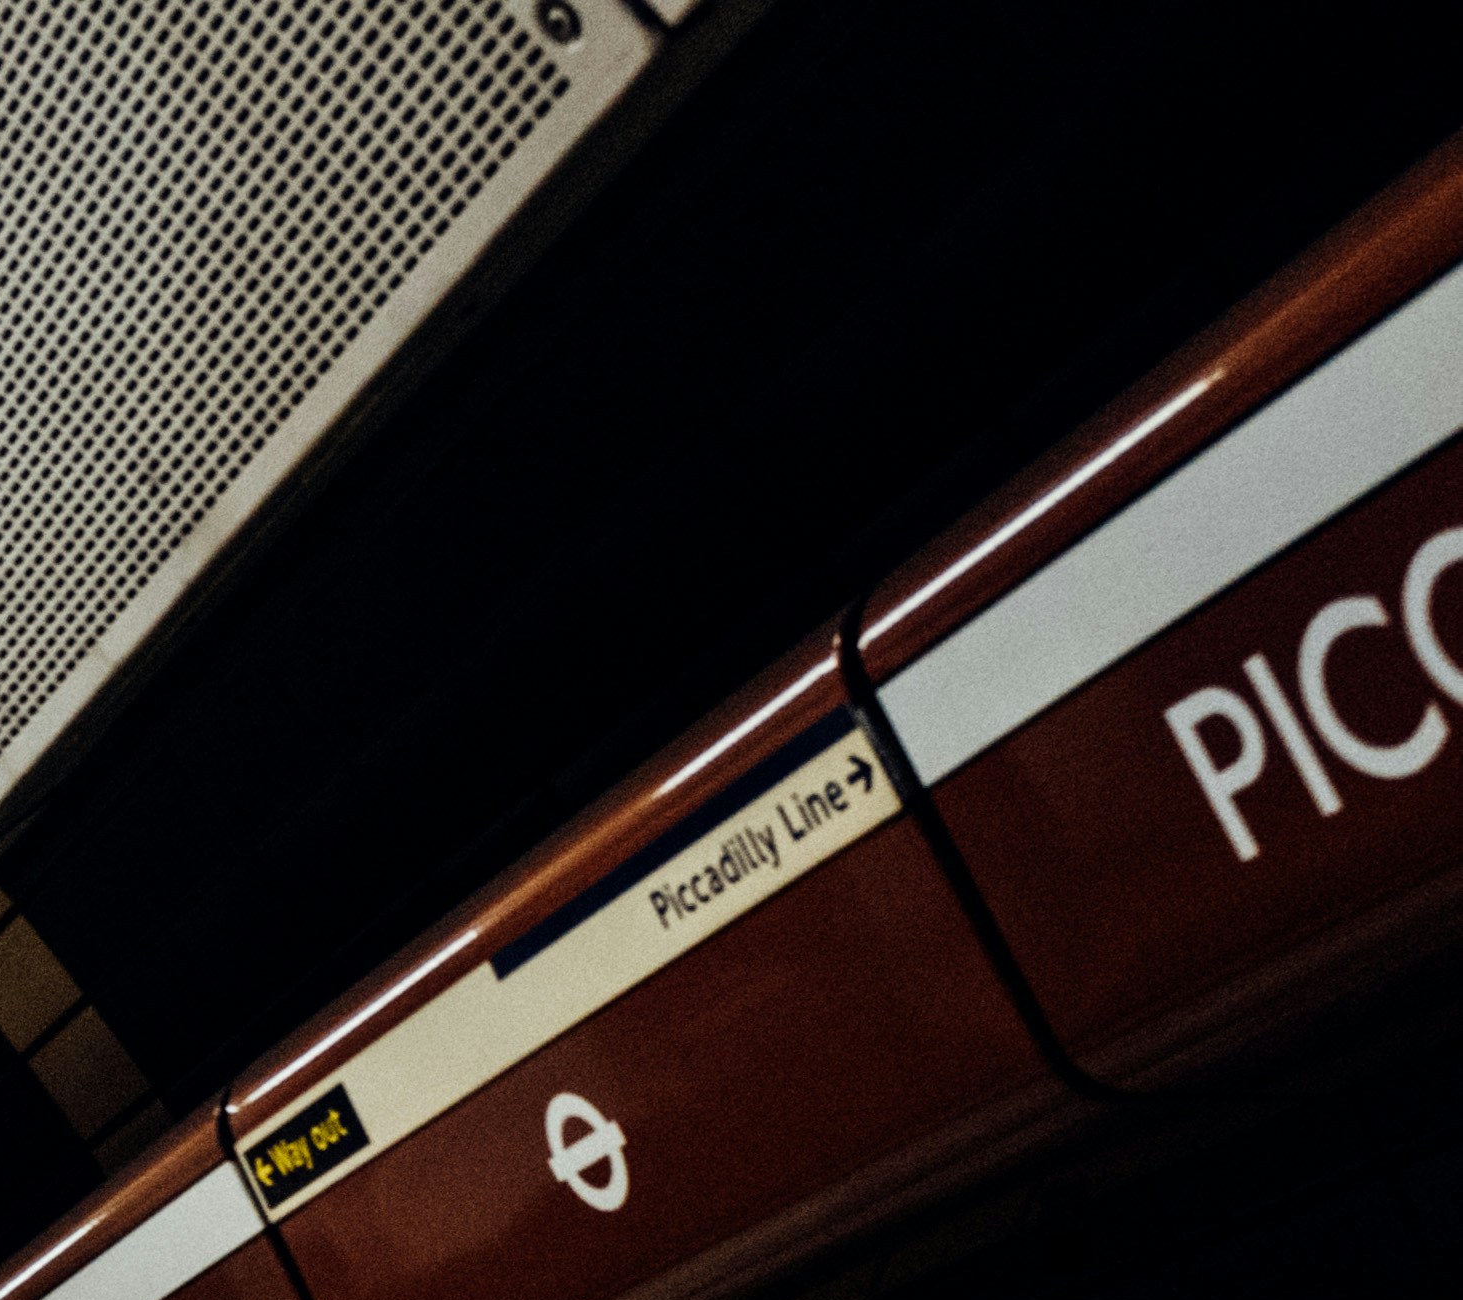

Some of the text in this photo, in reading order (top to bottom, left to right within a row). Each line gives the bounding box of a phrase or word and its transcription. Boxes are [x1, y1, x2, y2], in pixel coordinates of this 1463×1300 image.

[649, 774, 848, 931] Piccadilly Line
[267, 1108, 349, 1177] Way out
